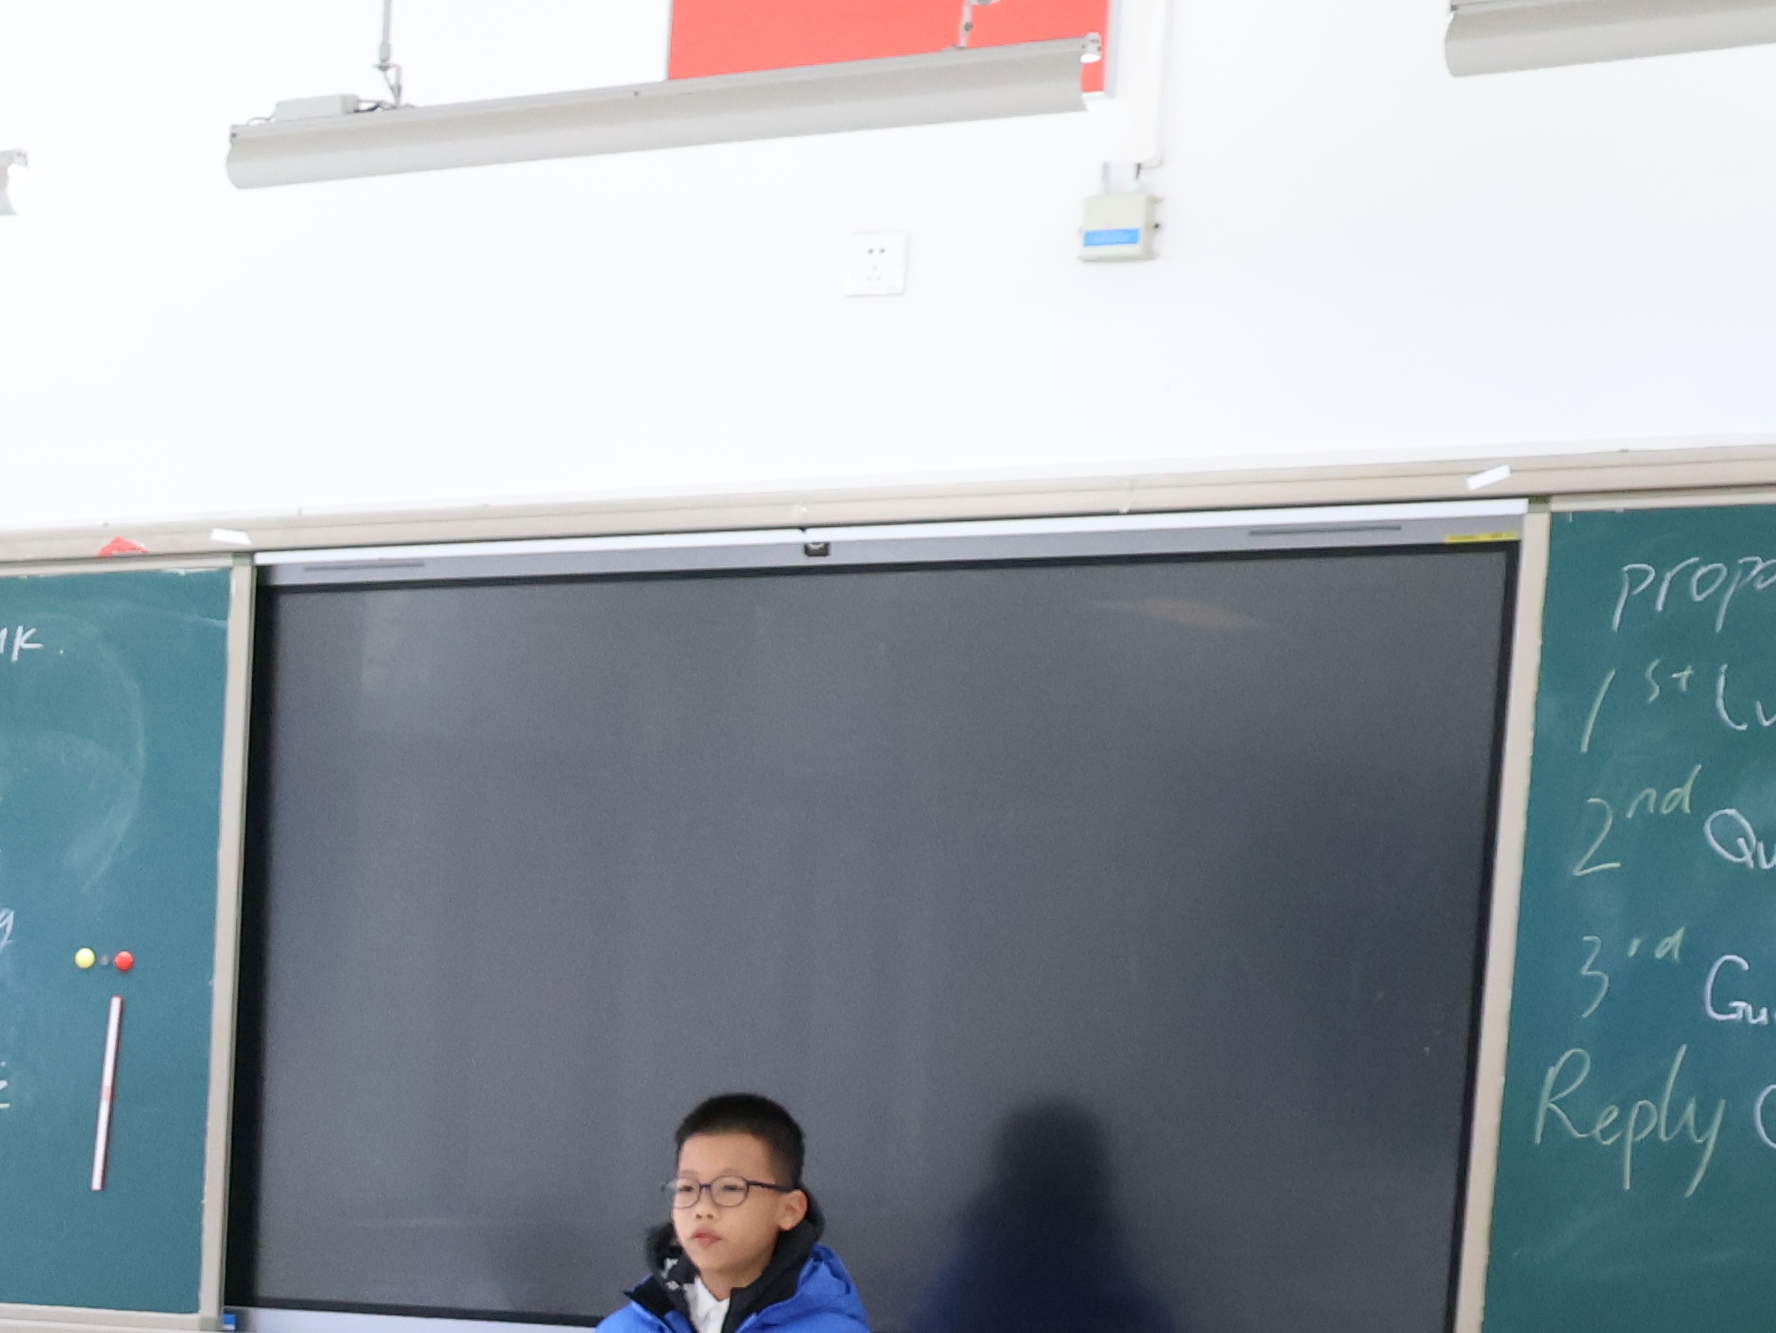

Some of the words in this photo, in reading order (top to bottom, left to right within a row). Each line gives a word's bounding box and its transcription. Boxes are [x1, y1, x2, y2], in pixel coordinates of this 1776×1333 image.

[1579, 656, 1695, 753] 1st
[1572, 764, 1702, 877] 2nd
[1533, 1042, 1727, 1199] Reply
